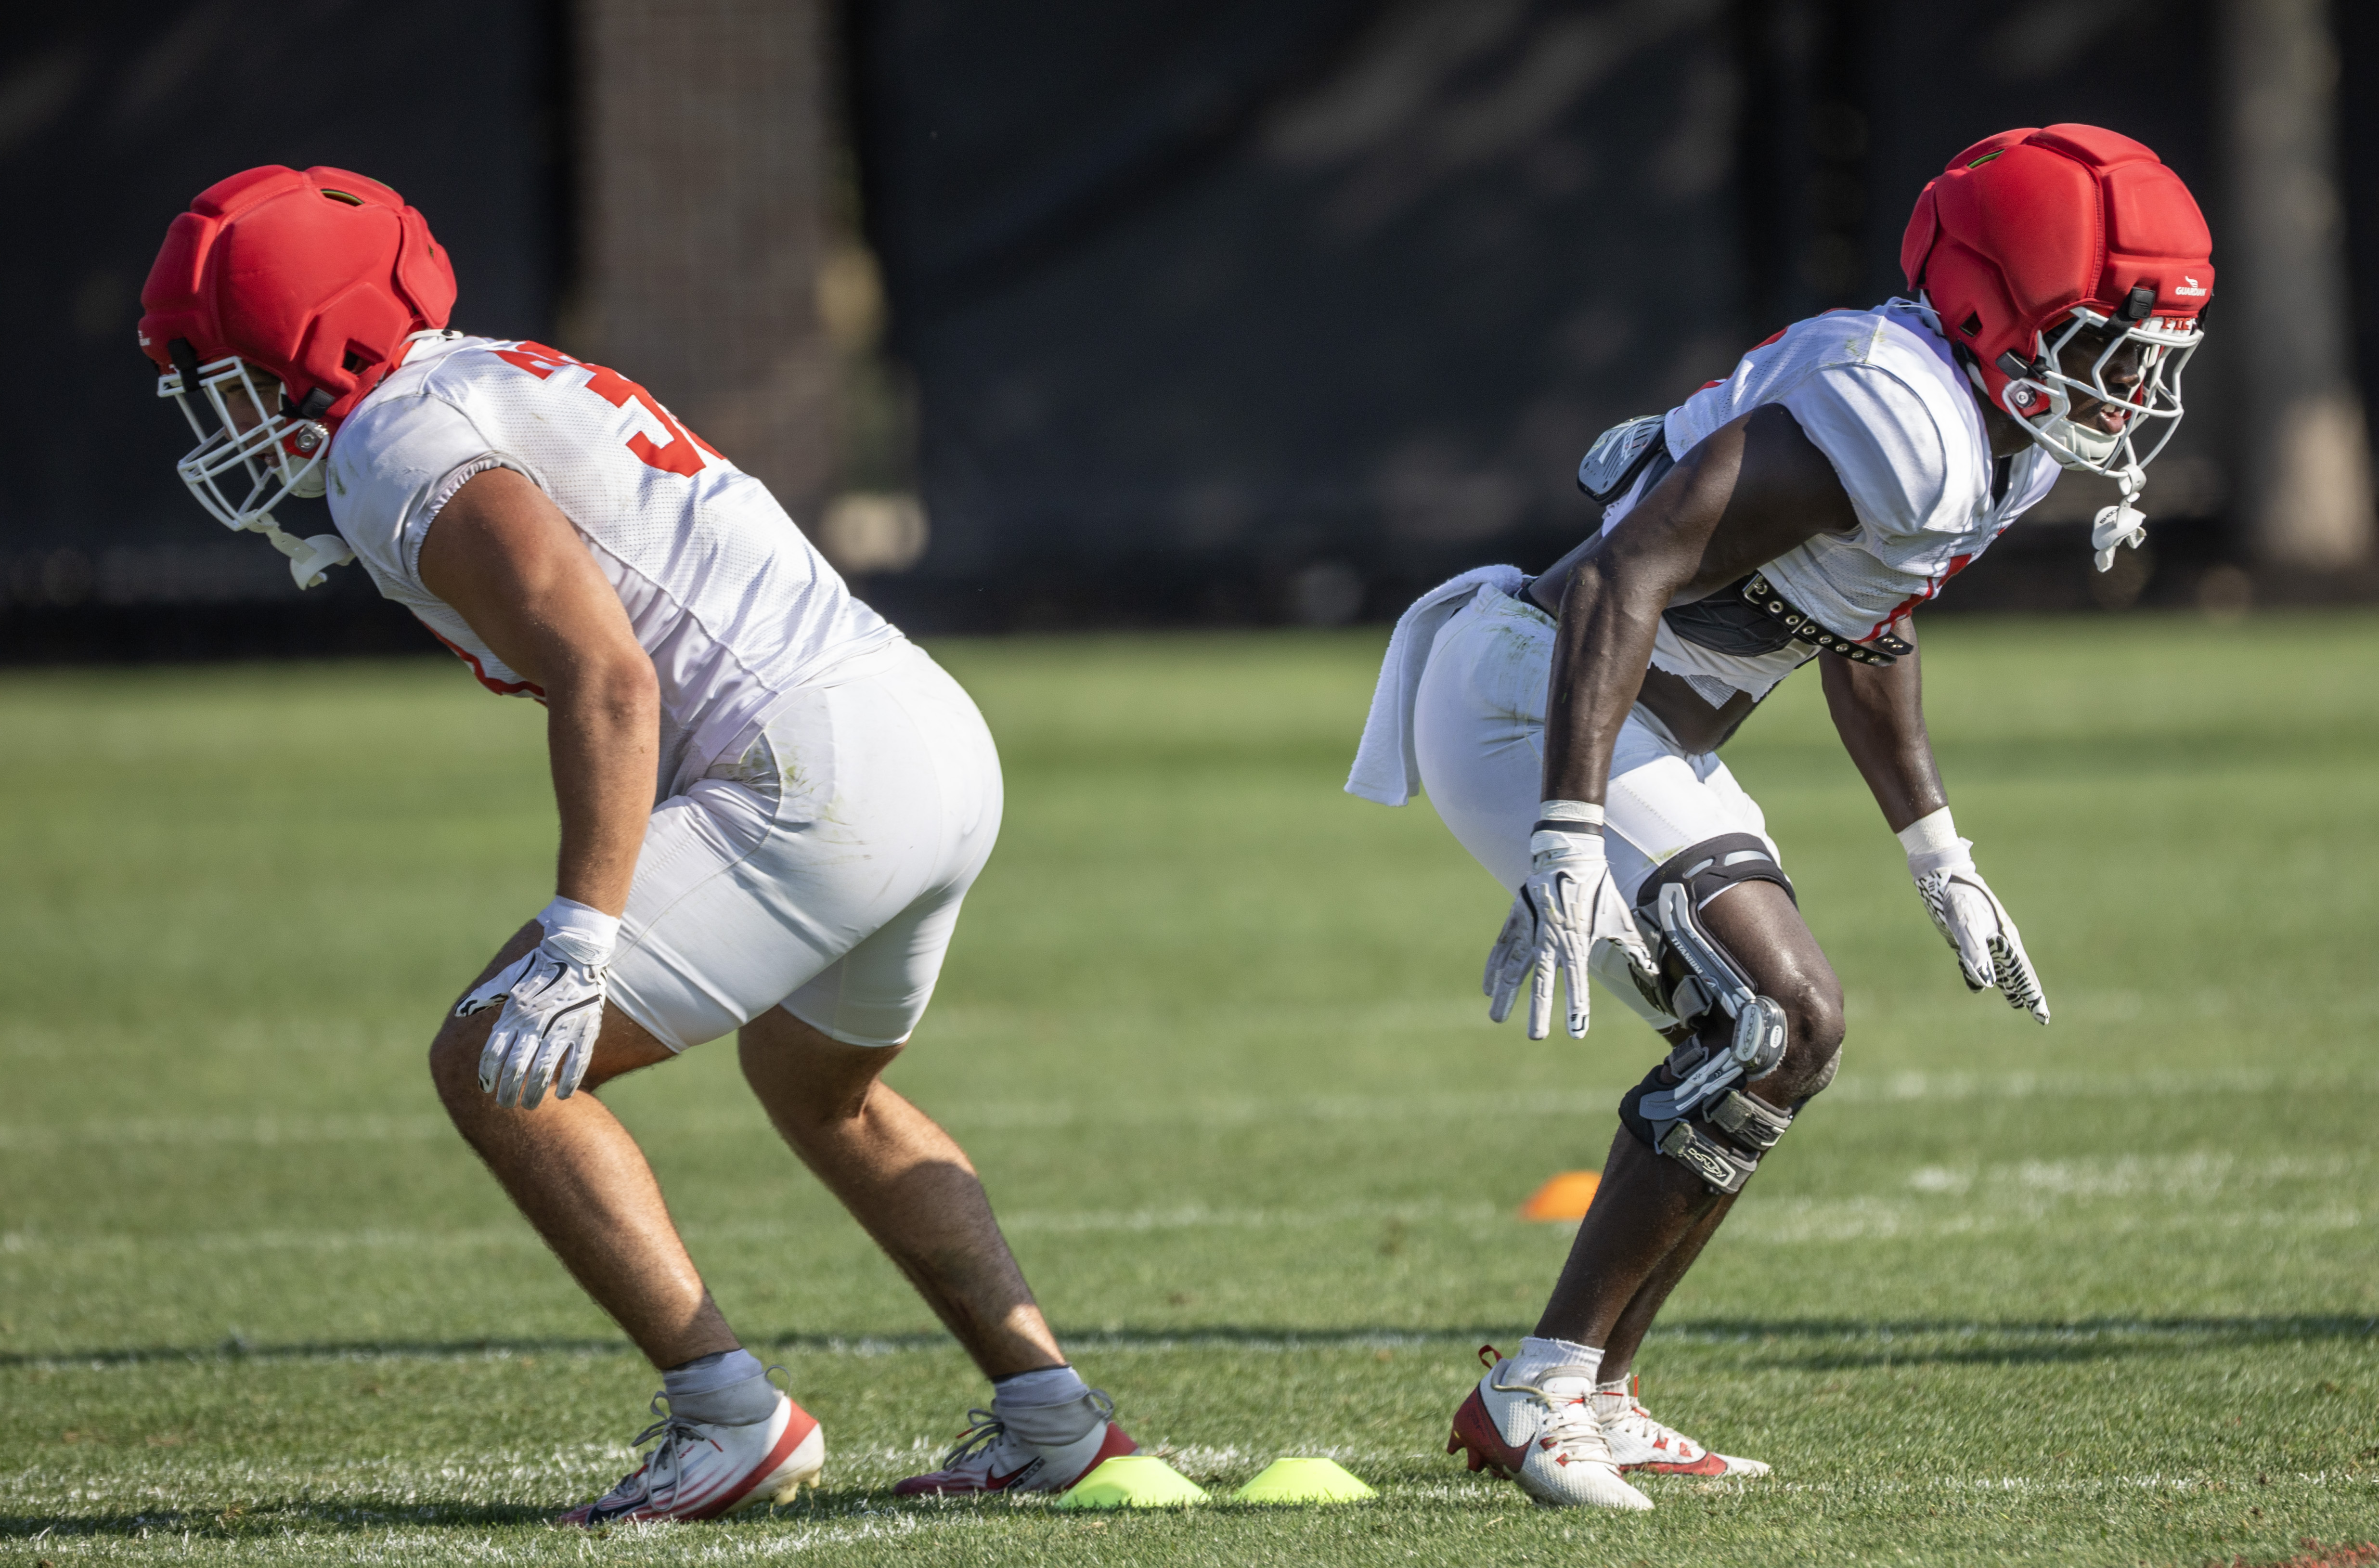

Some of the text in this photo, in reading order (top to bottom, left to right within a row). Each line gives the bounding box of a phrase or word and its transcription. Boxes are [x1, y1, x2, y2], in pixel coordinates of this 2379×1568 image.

[2175, 286, 2207, 296] GUARDIAN
[2099, 508, 2119, 524] SHOC
[1671, 936, 1703, 974] TITANIUM
[1743, 1007, 1756, 1058] DONJOY
[1687, 1148, 1727, 1177] DONJOY
